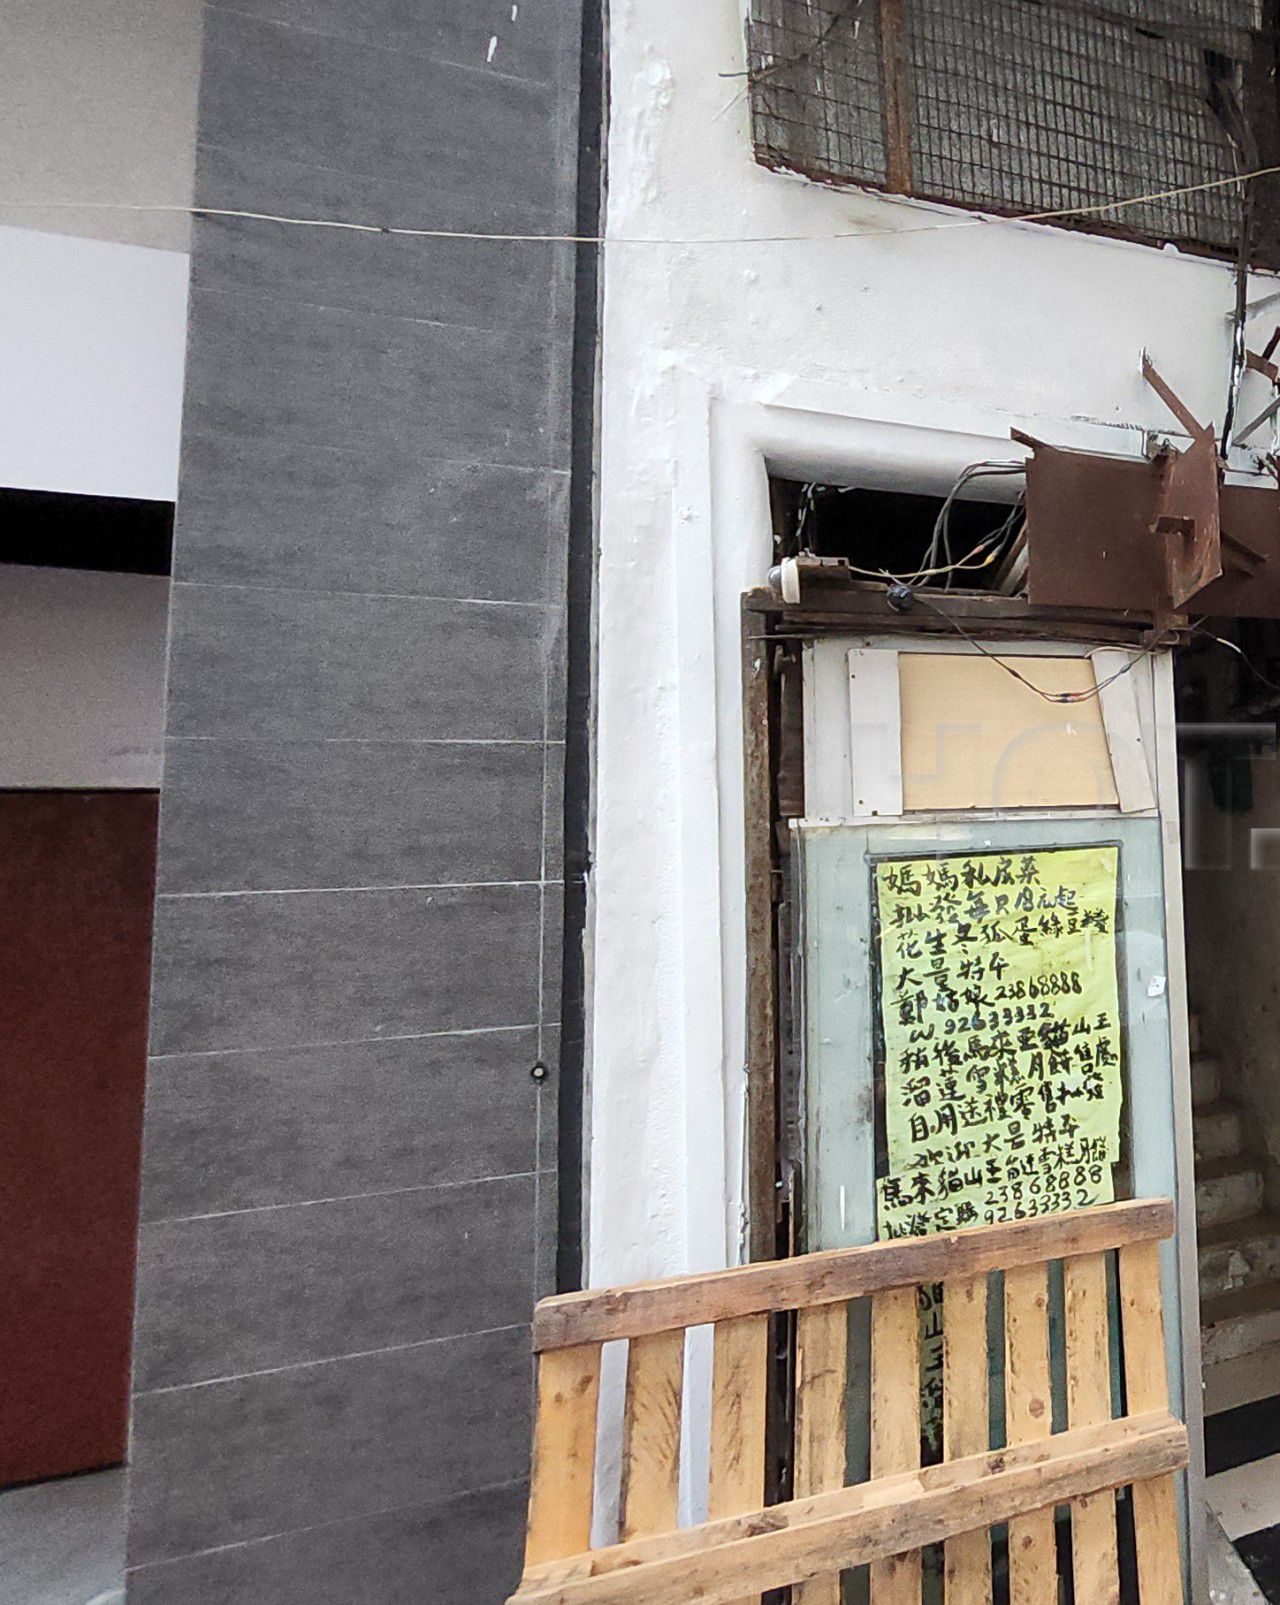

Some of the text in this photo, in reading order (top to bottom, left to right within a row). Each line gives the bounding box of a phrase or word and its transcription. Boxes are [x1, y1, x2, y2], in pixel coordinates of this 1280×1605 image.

[994, 972, 1082, 1000] 23868888
[984, 1164, 1102, 1205] 23868888
[984, 1189, 1099, 1225] 92633332
